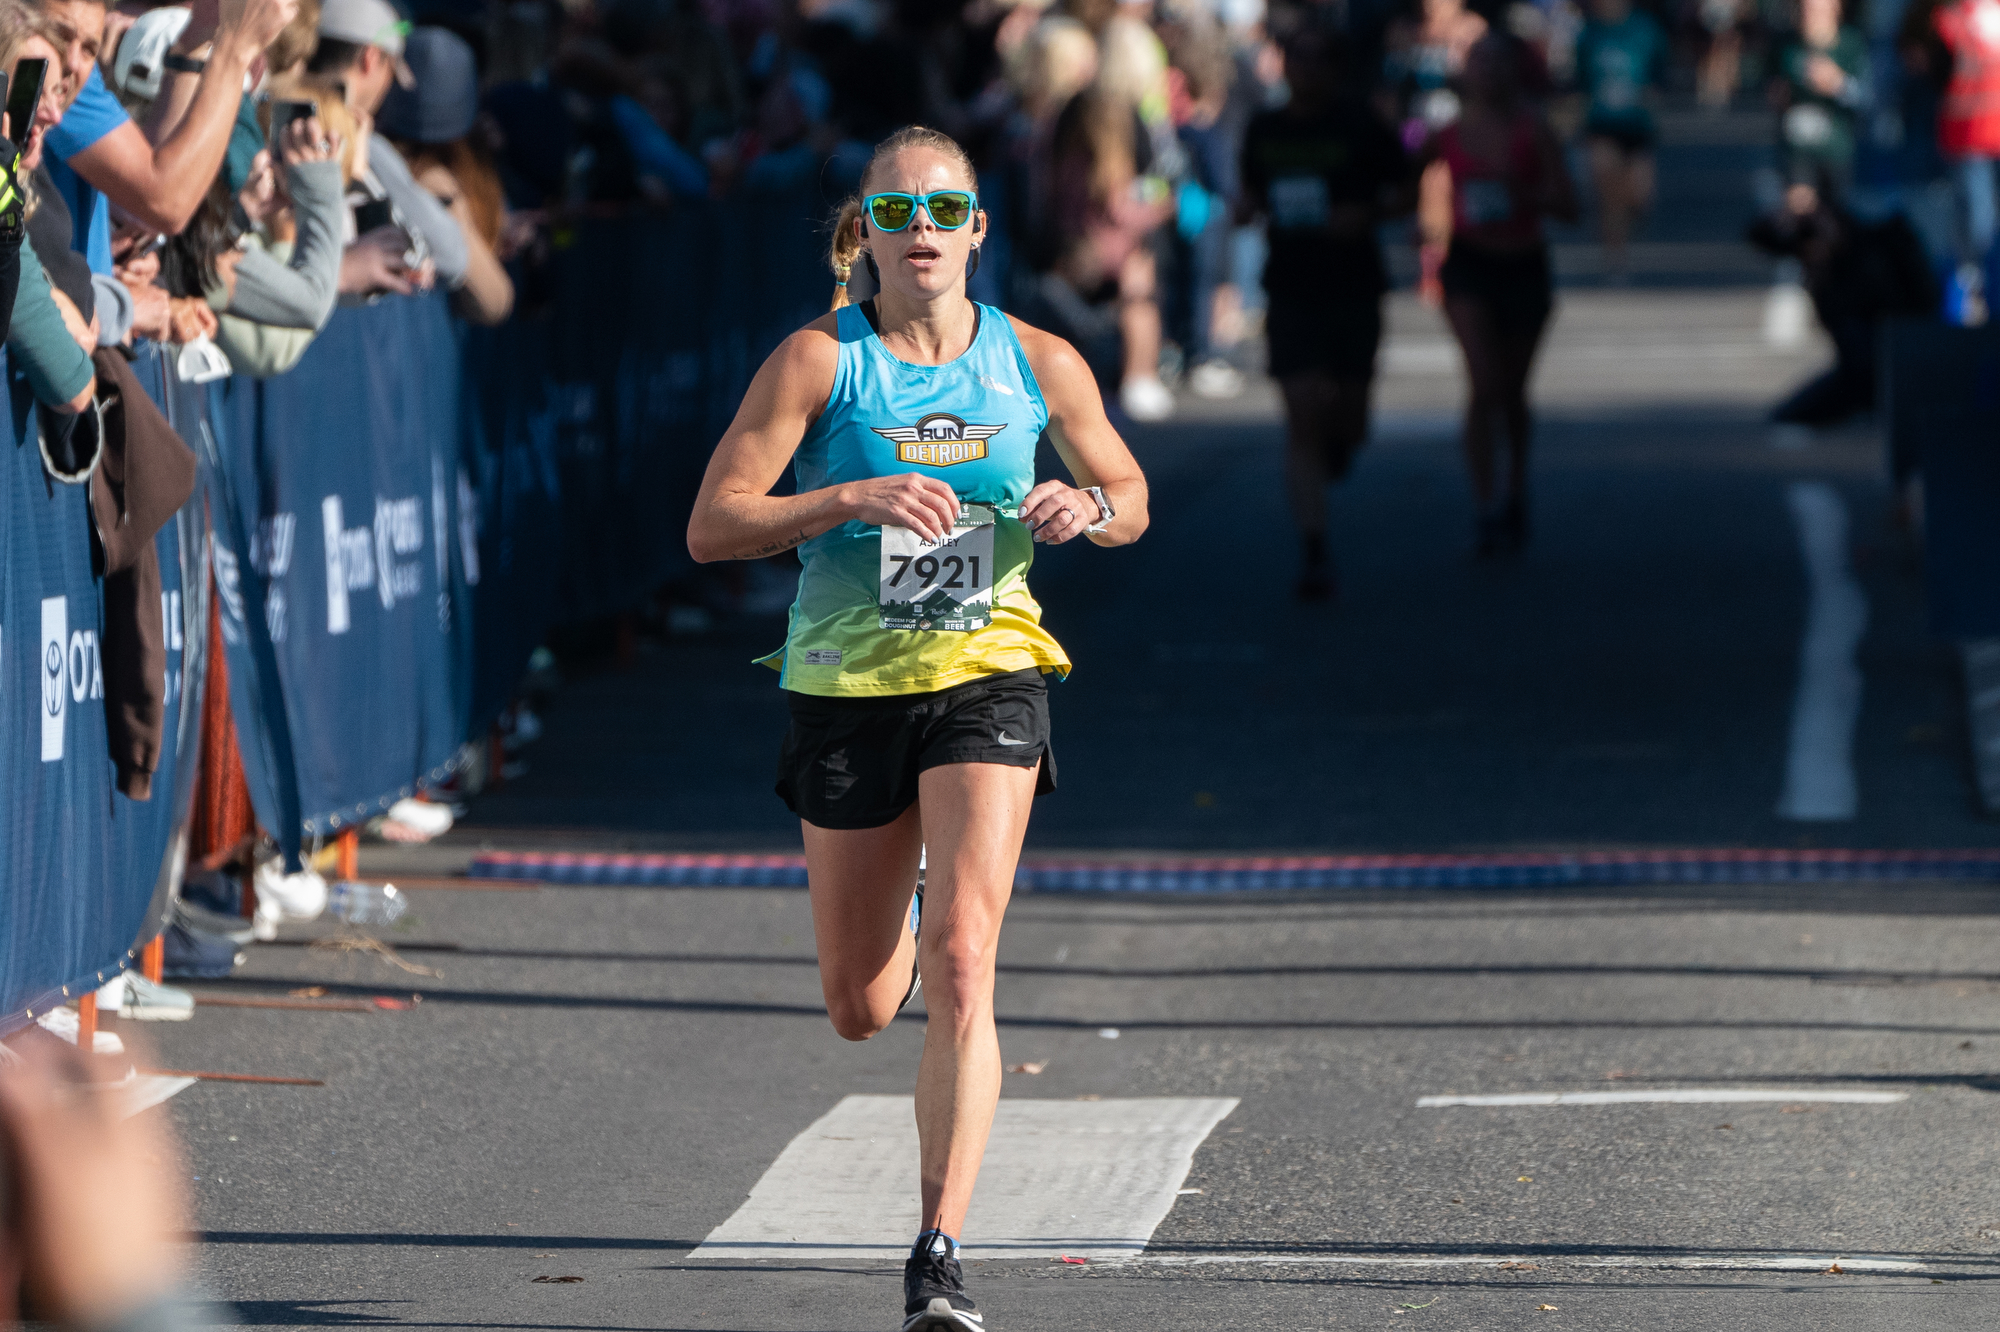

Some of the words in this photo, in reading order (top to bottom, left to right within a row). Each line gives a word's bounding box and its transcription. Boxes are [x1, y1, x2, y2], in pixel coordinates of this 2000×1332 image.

[921, 427, 961, 440] RUN
[905, 442, 980, 464] DETROIT
[889, 555, 980, 588] 7921
